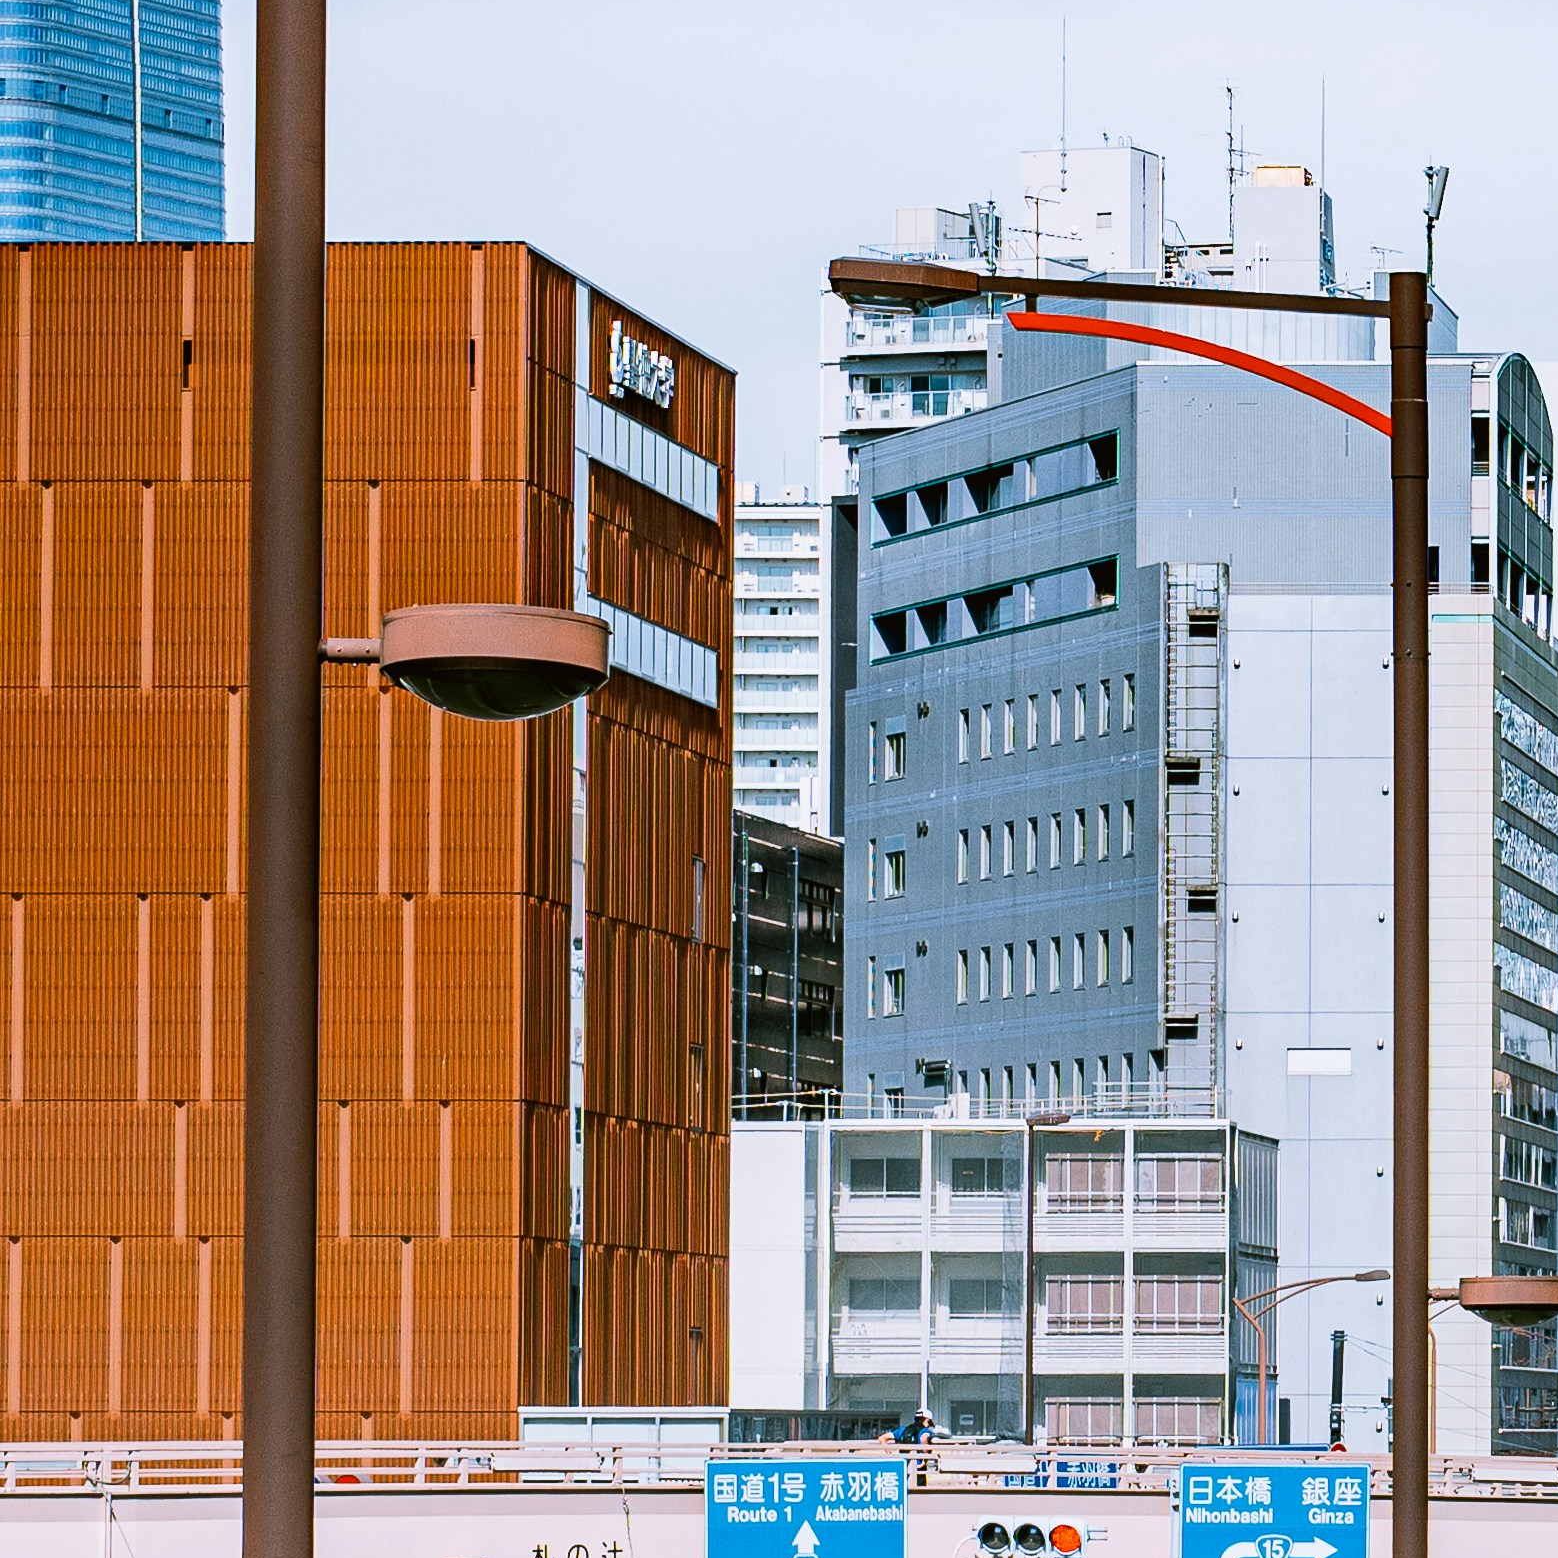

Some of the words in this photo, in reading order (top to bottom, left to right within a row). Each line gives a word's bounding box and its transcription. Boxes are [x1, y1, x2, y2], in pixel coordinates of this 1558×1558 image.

[713, 1472, 807, 1503] 国道1号
[819, 1471, 900, 1502] 赤羽橋
[1189, 1475, 1272, 1505] 日本橋
[1301, 1476, 1362, 1506] 銀座
[727, 1505, 778, 1523] Route
[784, 1505, 792, 1523] 1
[815, 1504, 904, 1522] Akabanebashi
[1185, 1507, 1274, 1524] Nihonbashi
[1308, 1507, 1355, 1524] Ginza
